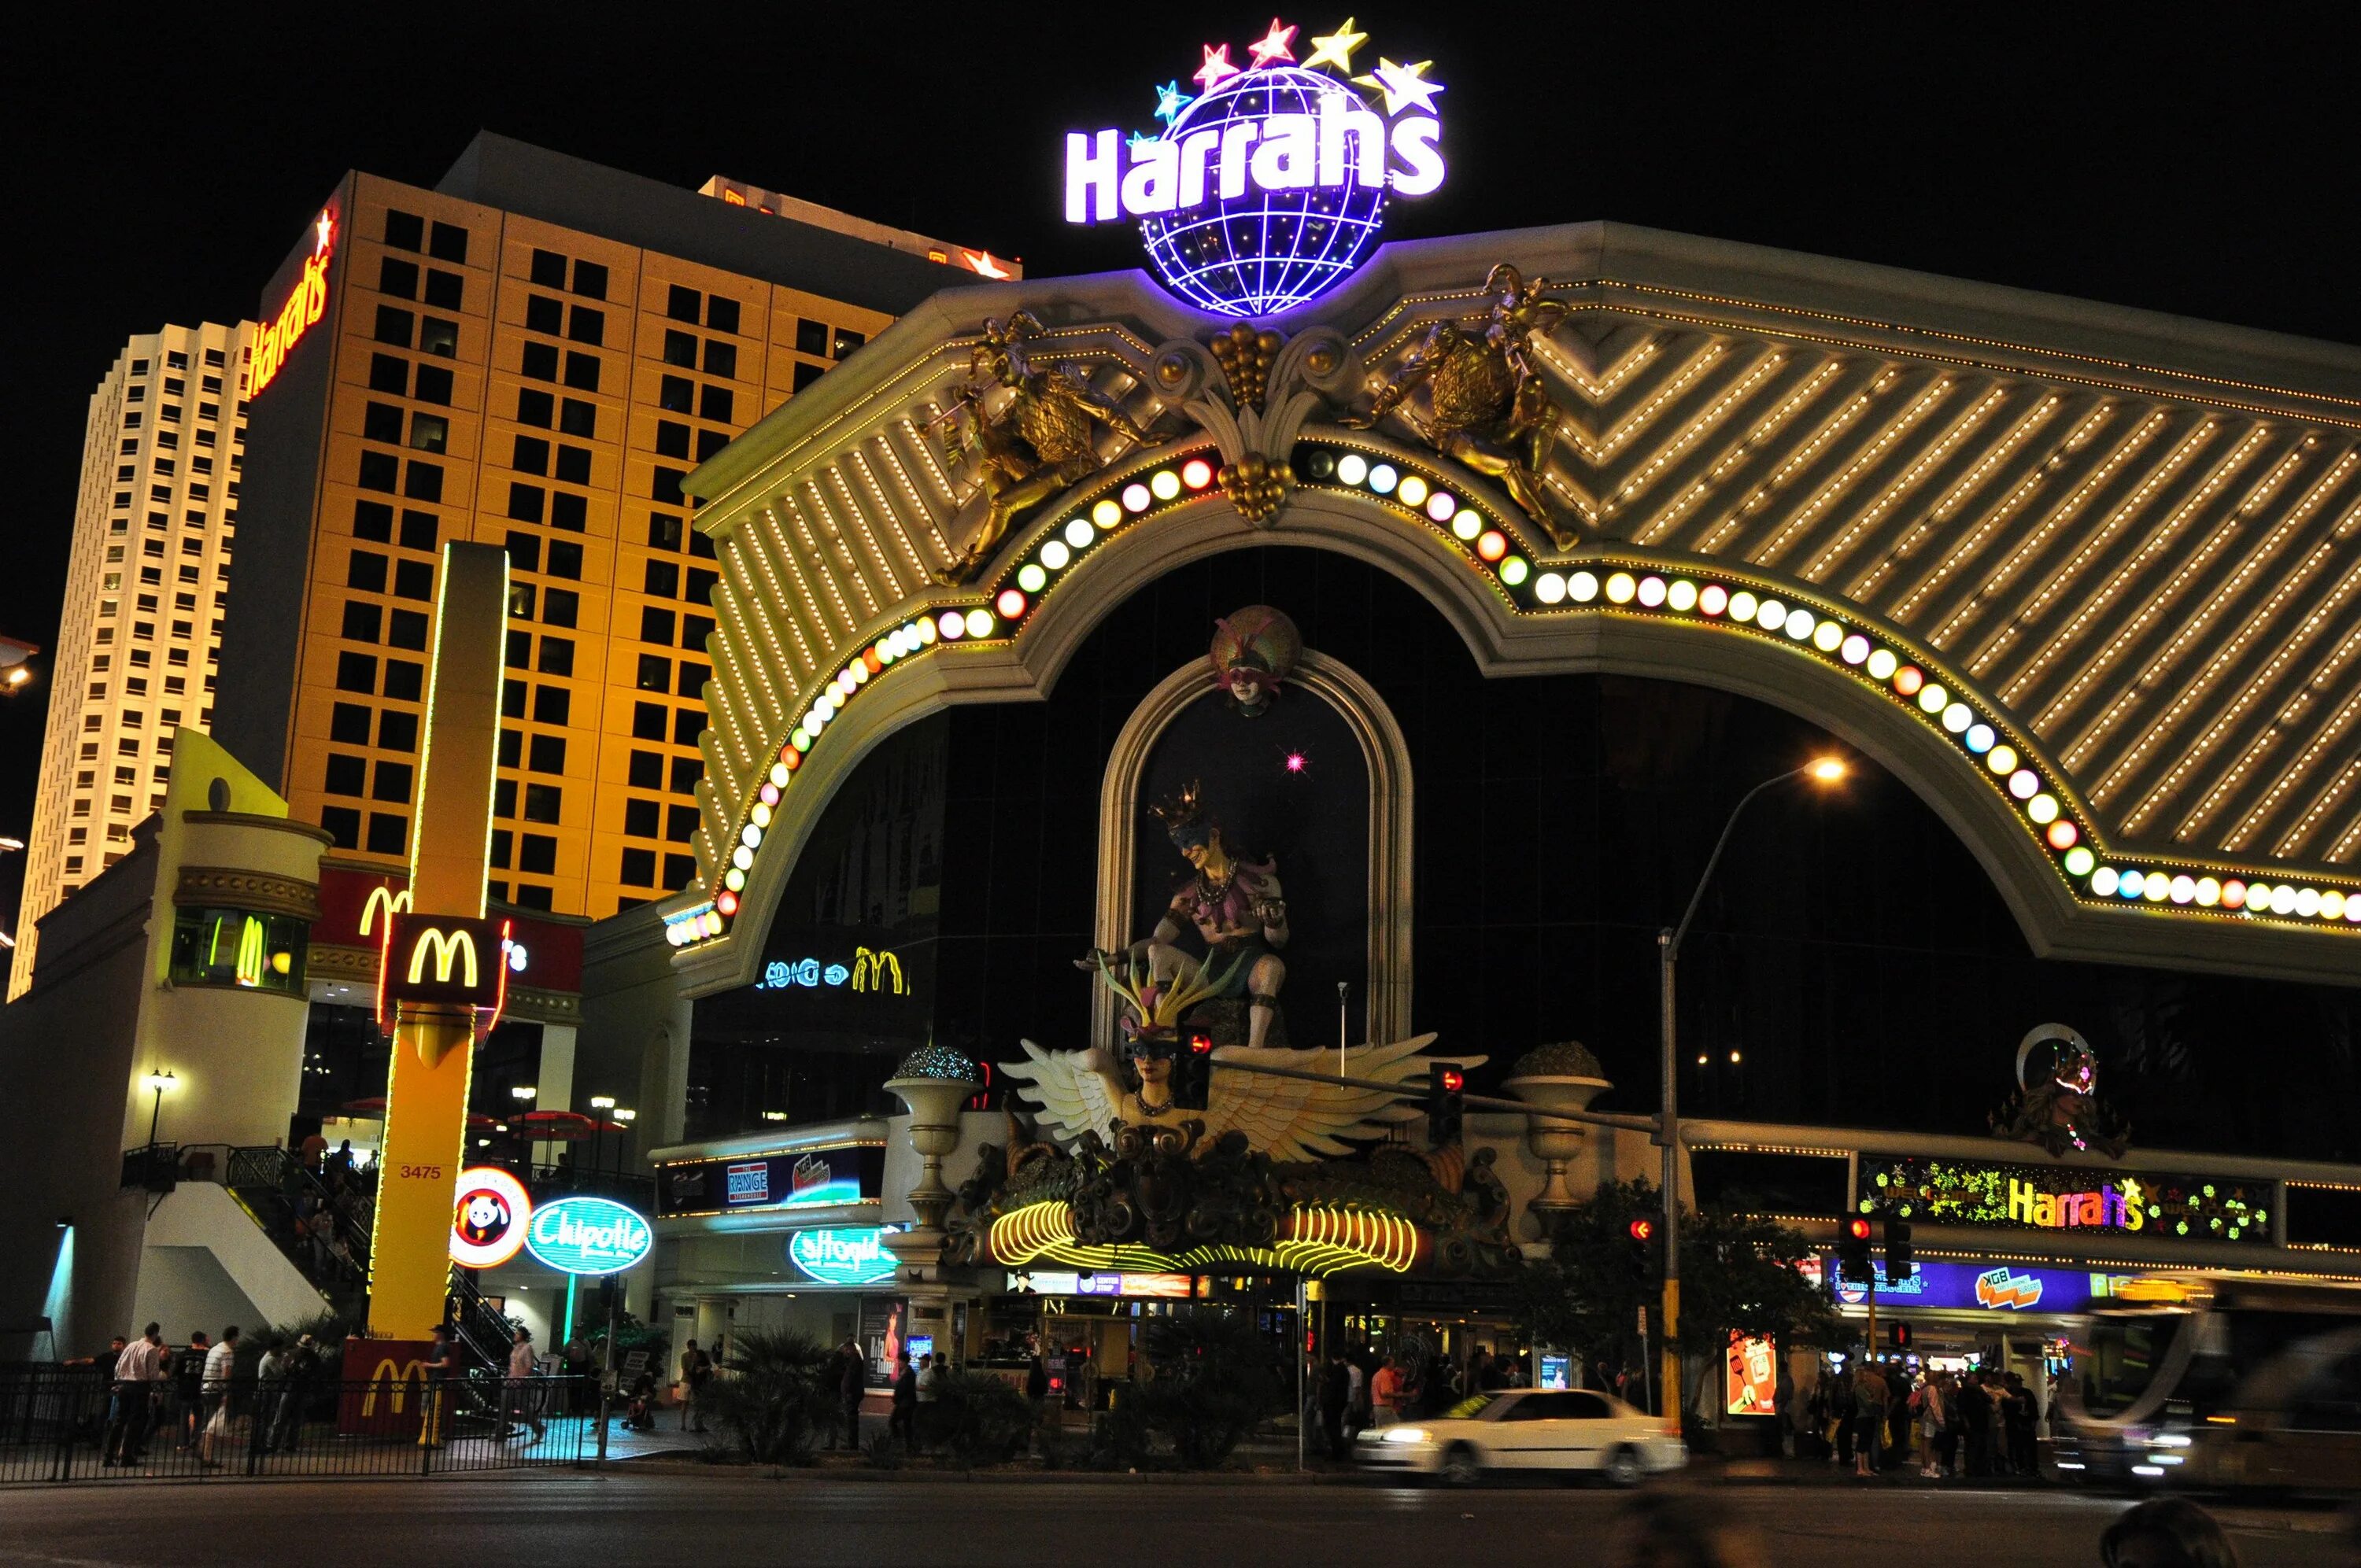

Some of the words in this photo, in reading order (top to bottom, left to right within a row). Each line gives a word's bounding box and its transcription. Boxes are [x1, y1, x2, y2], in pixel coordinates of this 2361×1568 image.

[401, 1166, 441, 1179] 3475
[729, 1172, 767, 1193] RANGE
[534, 1207, 646, 1259] Chipotle
[1982, 1271, 2008, 1286] KGB
